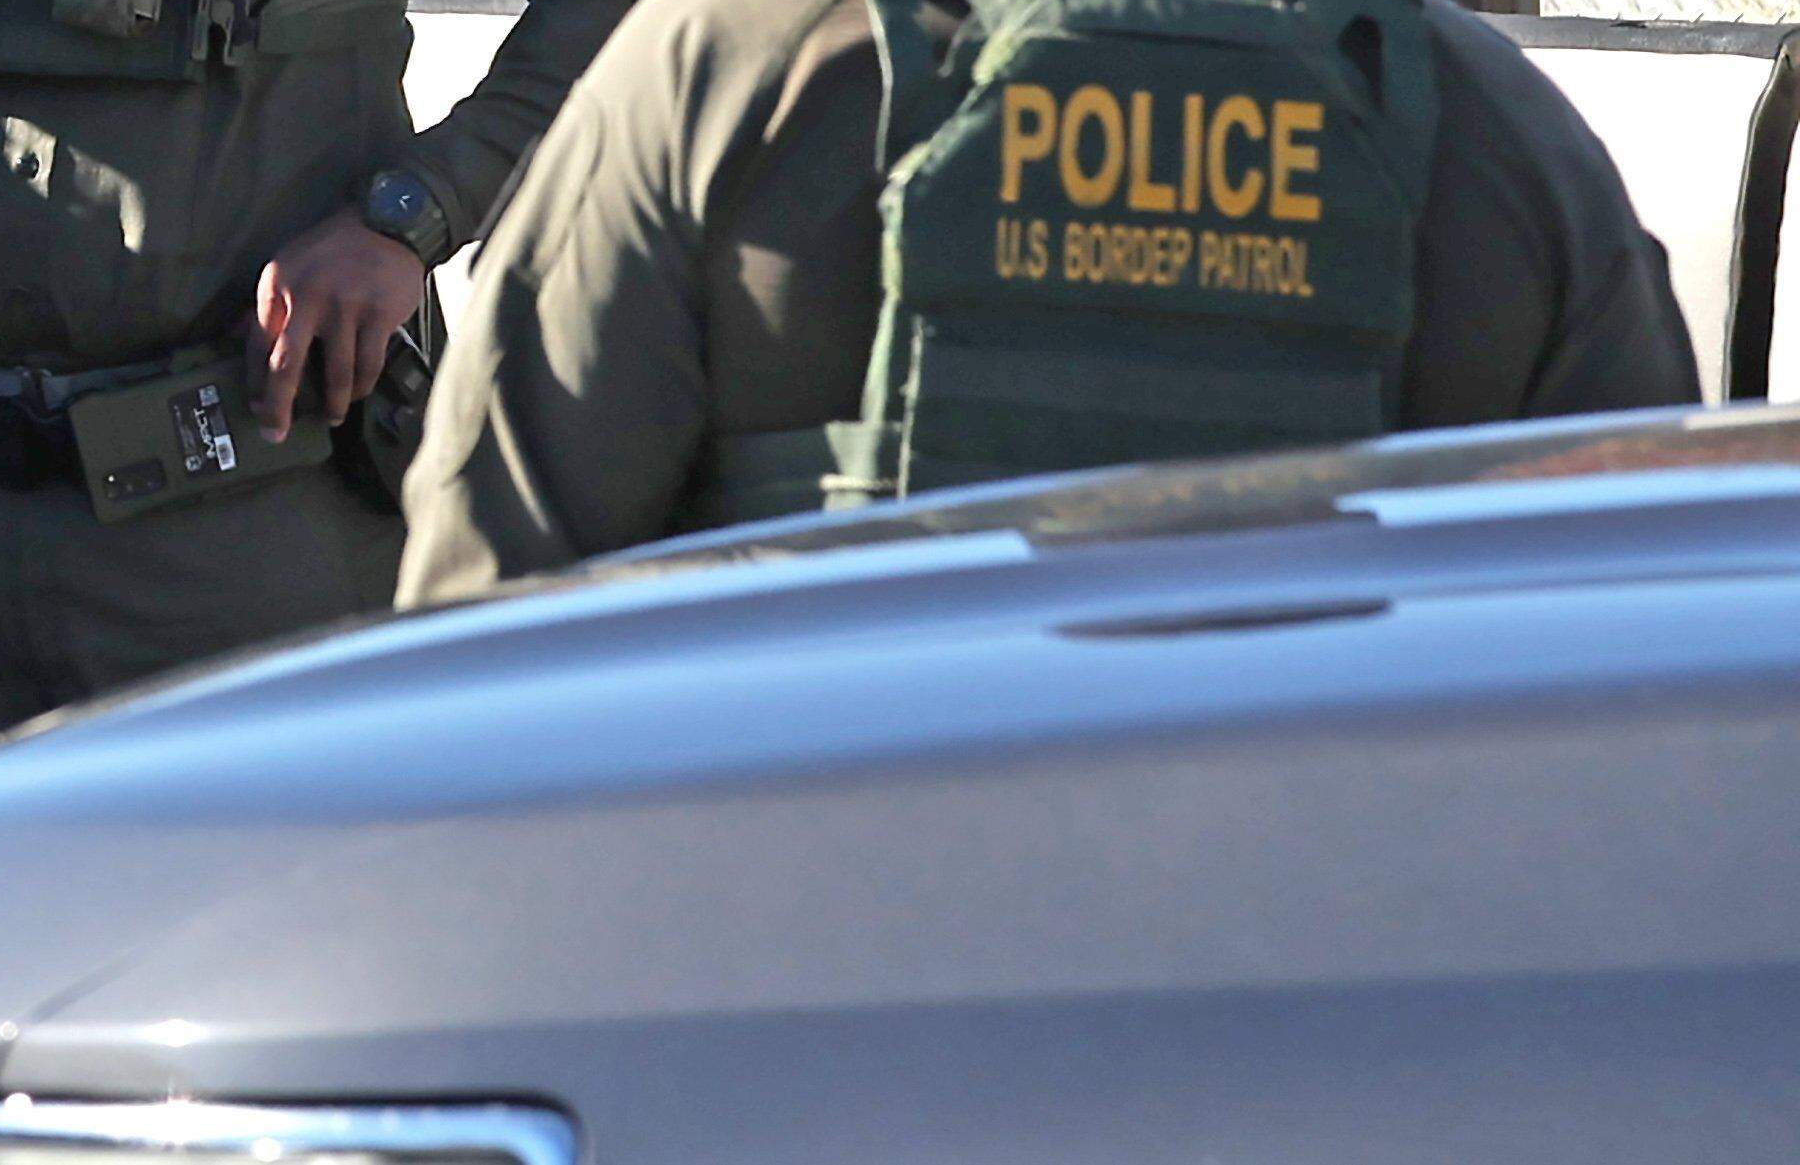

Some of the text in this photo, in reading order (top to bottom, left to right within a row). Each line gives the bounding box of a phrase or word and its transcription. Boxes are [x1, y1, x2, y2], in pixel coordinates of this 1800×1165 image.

[1000, 82, 1325, 222] POLICE
[1062, 220, 1194, 287] BORDER
[1200, 229, 1315, 299] PATROL
